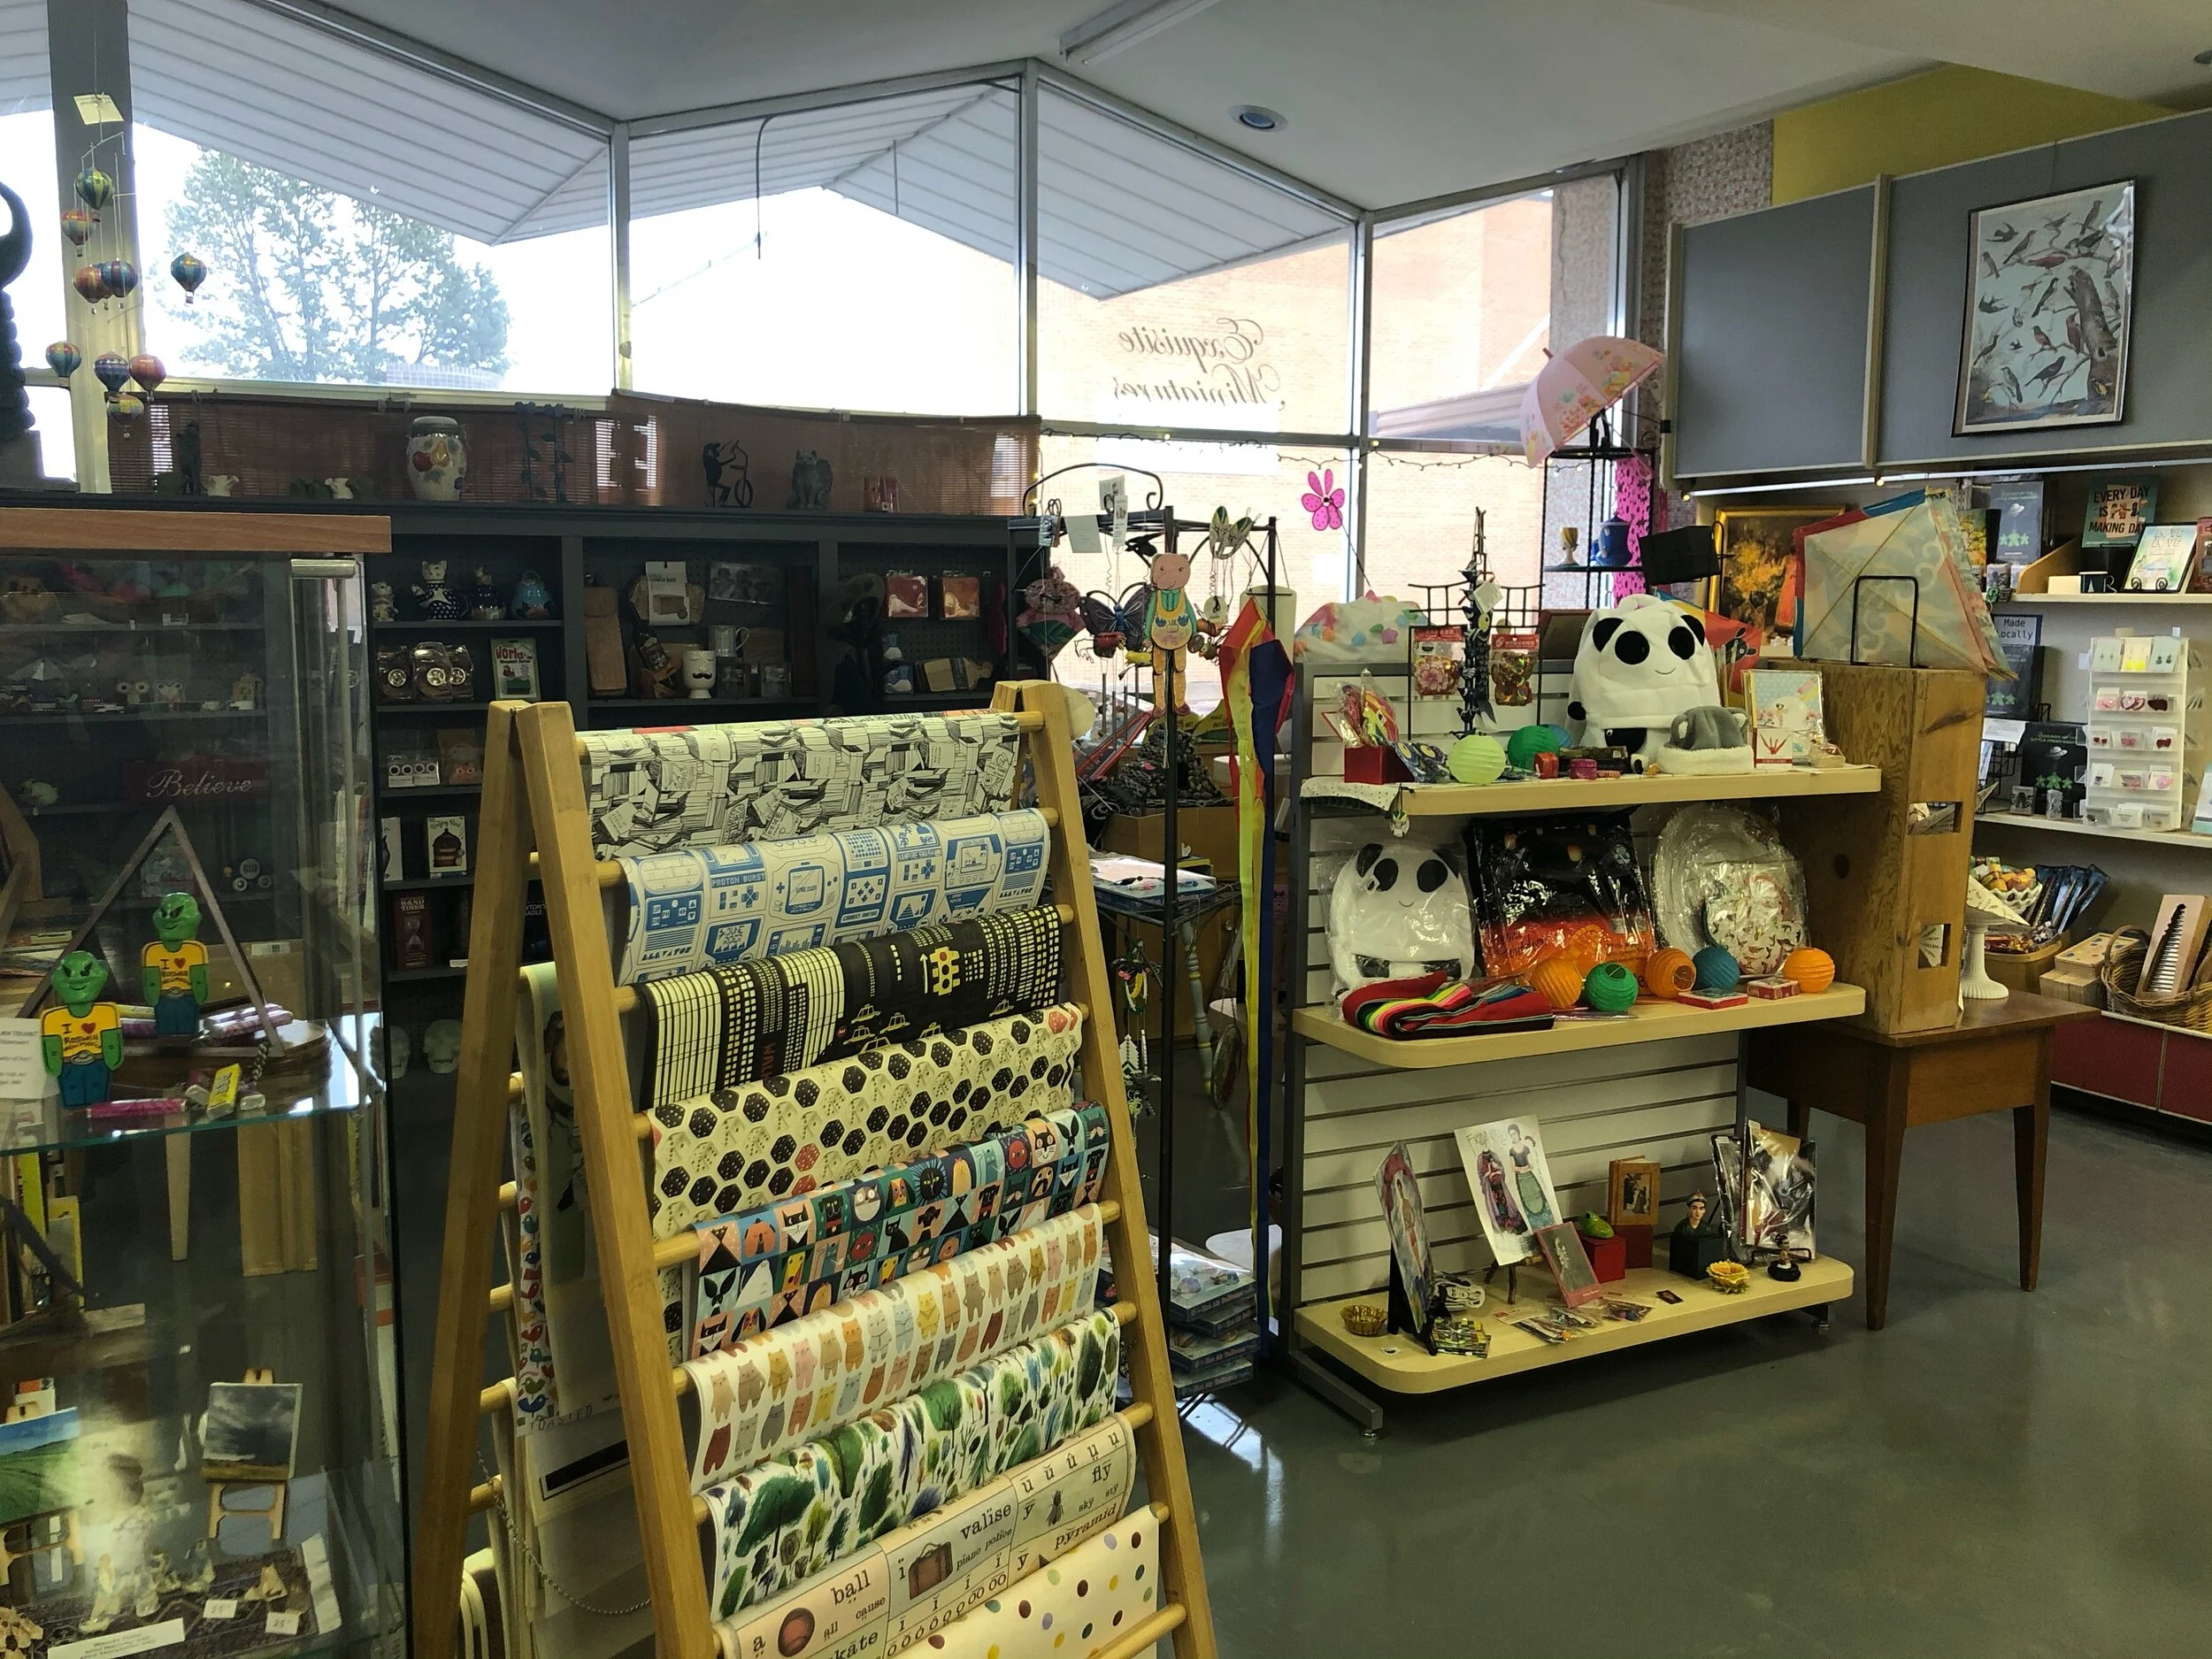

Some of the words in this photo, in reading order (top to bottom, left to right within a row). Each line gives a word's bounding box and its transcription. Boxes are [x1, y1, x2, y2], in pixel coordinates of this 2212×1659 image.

[2093, 488, 2126, 503] EVERY
[2131, 486, 2150, 499] DAY
[2099, 506, 2108, 518] IS
[2089, 521, 2125, 534] MAKING
[2003, 618, 2026, 627] Made
[146, 769, 253, 798] Believe
[711, 875, 740, 887] PROTON
[743, 872, 765, 883] BURST
[160, 958, 170, 970] I
[61, 1023, 73, 1034] I
